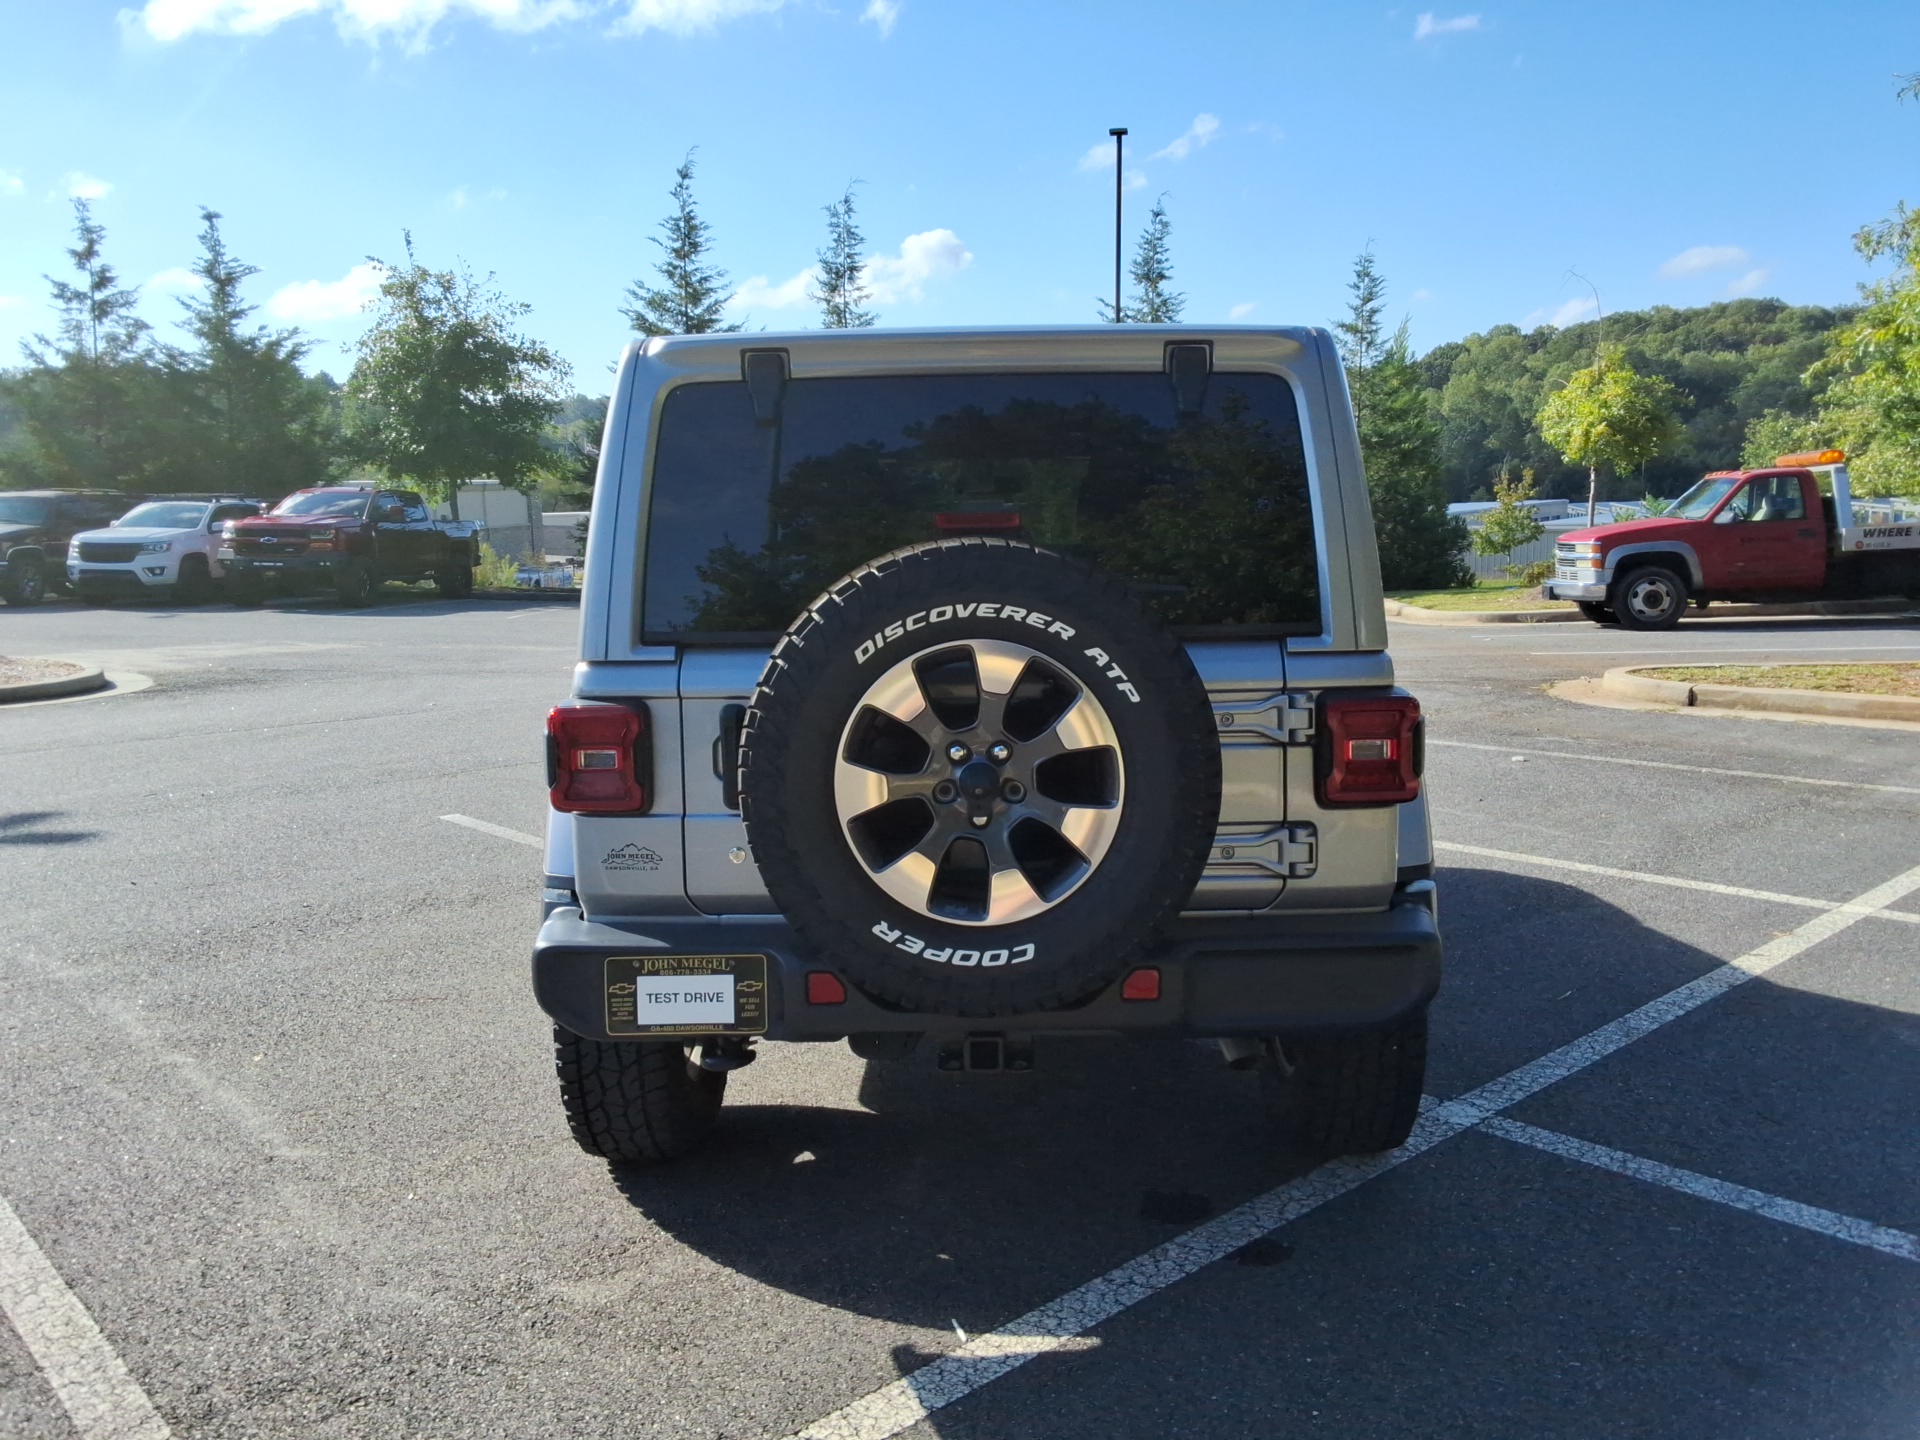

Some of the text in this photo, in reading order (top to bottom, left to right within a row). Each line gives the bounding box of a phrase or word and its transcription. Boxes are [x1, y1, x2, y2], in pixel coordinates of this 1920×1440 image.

[1863, 526, 1913, 538] WHERE
[853, 602, 1141, 705] DISCOVERER ATP
[607, 853, 627, 861] JOHN
[871, 919, 1036, 967] COOPER
[642, 957, 730, 974] JOHN MEGEL
[646, 992, 680, 1004] TEST
[684, 991, 724, 1003] DRIVE
